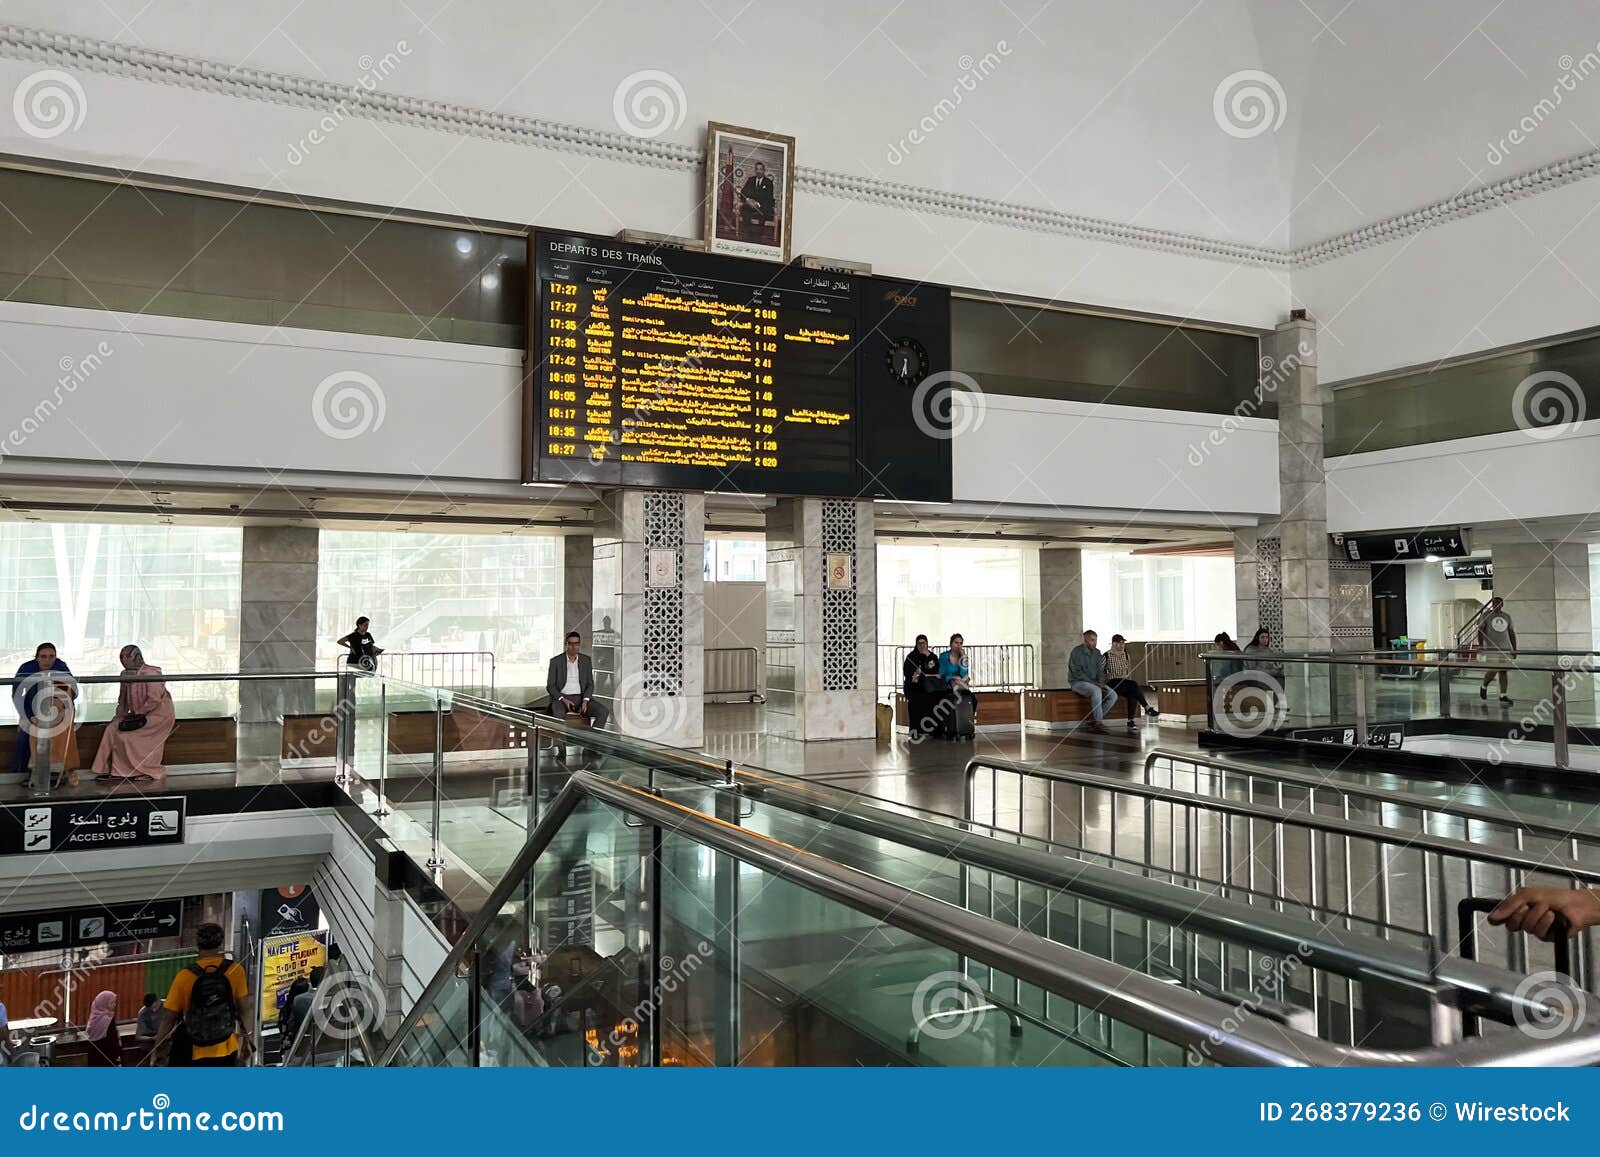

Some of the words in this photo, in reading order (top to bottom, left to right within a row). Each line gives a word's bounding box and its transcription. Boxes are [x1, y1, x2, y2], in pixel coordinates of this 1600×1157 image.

[550, 242, 598, 257] DEPARTS
[602, 249, 623, 260] DES
[627, 252, 662, 266] TRAINS
[804, 278, 830, 288] القطارات
[550, 283, 577, 295] 17:27
[550, 301, 577, 312] 17:27
[754, 308, 761, 318] 2
[550, 319, 576, 330] 17:35
[754, 324, 761, 334] 2
[763, 326, 777, 336] 155
[755, 341, 760, 351] 1
[763, 342, 777, 353] 142
[549, 354, 576, 366] 17:42
[754, 357, 761, 367] 2
[762, 358, 772, 368] 41
[549, 372, 576, 384] 18:05
[755, 374, 760, 384] 1
[549, 390, 576, 401] 18:05
[755, 391, 760, 400] 1
[549, 407, 576, 419] 18:17
[755, 407, 760, 417] 1
[754, 423, 761, 433] 2
[762, 424, 773, 434] 43
[755, 440, 760, 450] 1
[754, 456, 761, 467] 2
[69, 813, 103, 825] السكة
[107, 812, 138, 828] ولوج
[70, 832, 105, 842] ACCES
[106, 831, 137, 840] VOIES
[267, 941, 299, 957] NAVETTE
